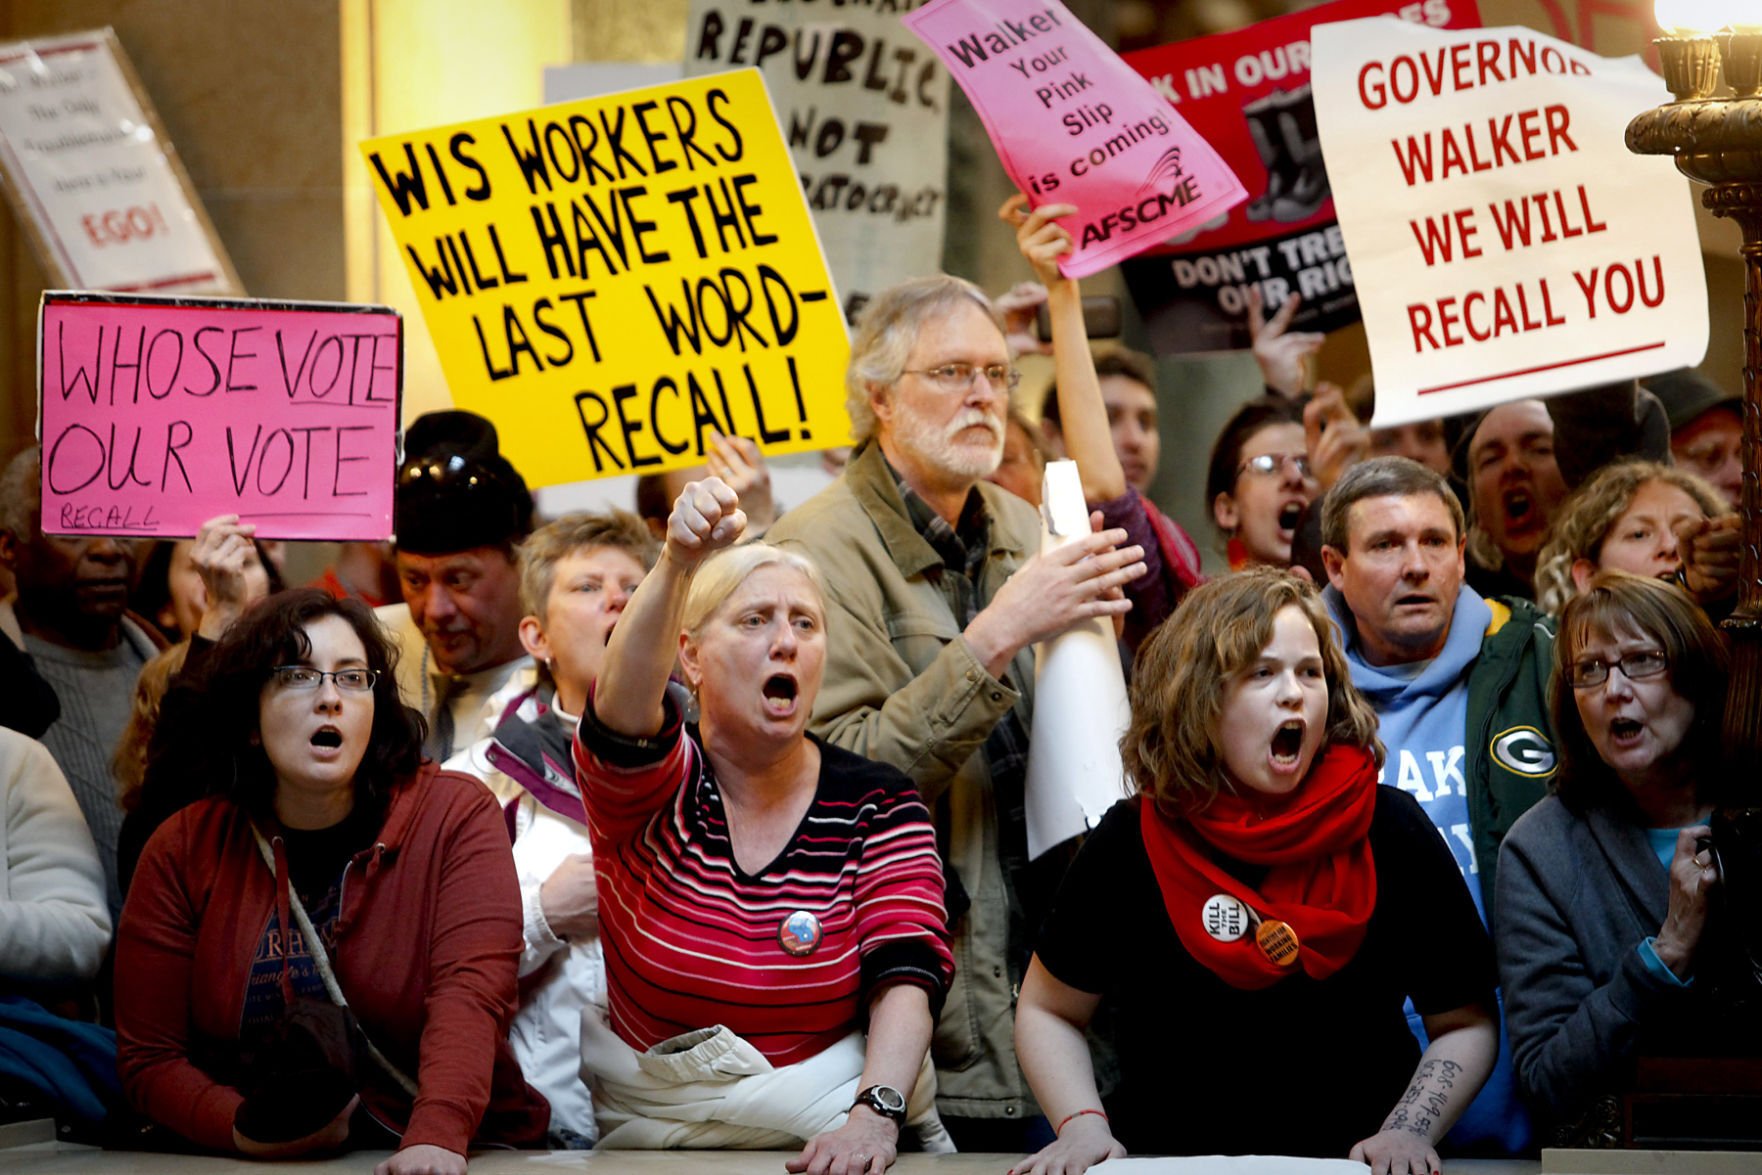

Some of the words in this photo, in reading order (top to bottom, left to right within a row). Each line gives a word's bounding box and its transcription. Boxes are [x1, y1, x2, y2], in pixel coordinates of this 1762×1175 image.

[697, 9, 940, 111] REPUBLIC
[948, 8, 1064, 69] Walker
[1009, 44, 1070, 80] Your
[1186, 62, 1229, 101] IN
[1234, 40, 1312, 88] OUR
[1035, 70, 1095, 109] Pink
[1062, 100, 1114, 137] Slip
[369, 131, 492, 218] WIS
[500, 88, 745, 196] WORKERS
[789, 106, 889, 165] NOT
[1027, 171, 1061, 196] is
[1069, 108, 1174, 178] coming!
[1391, 103, 1580, 188] WALKER
[80, 201, 171, 250] EGO!
[406, 223, 529, 301] WILL
[529, 185, 671, 281] HAVE
[667, 173, 780, 260] THE
[1080, 174, 1203, 251] AFSCME
[1409, 208, 1484, 268] WE
[1489, 184, 1608, 251] WILL
[1172, 244, 1273, 290] DON'T
[472, 289, 603, 382] LAST
[643, 263, 828, 358] WORD-
[1406, 278, 1567, 354] RECALL
[1573, 255, 1667, 320] YOU
[58, 319, 264, 406] WHOSE
[275, 328, 398, 406] VOTE
[572, 356, 813, 474] RECALL!
[48, 419, 194, 495] OUR
[226, 423, 375, 500] VOTE
[60, 501, 160, 530] RECALL
[1495, 729, 1557, 775] G
[1208, 902, 1221, 936] KILL
[1228, 903, 1240, 935] BILL
